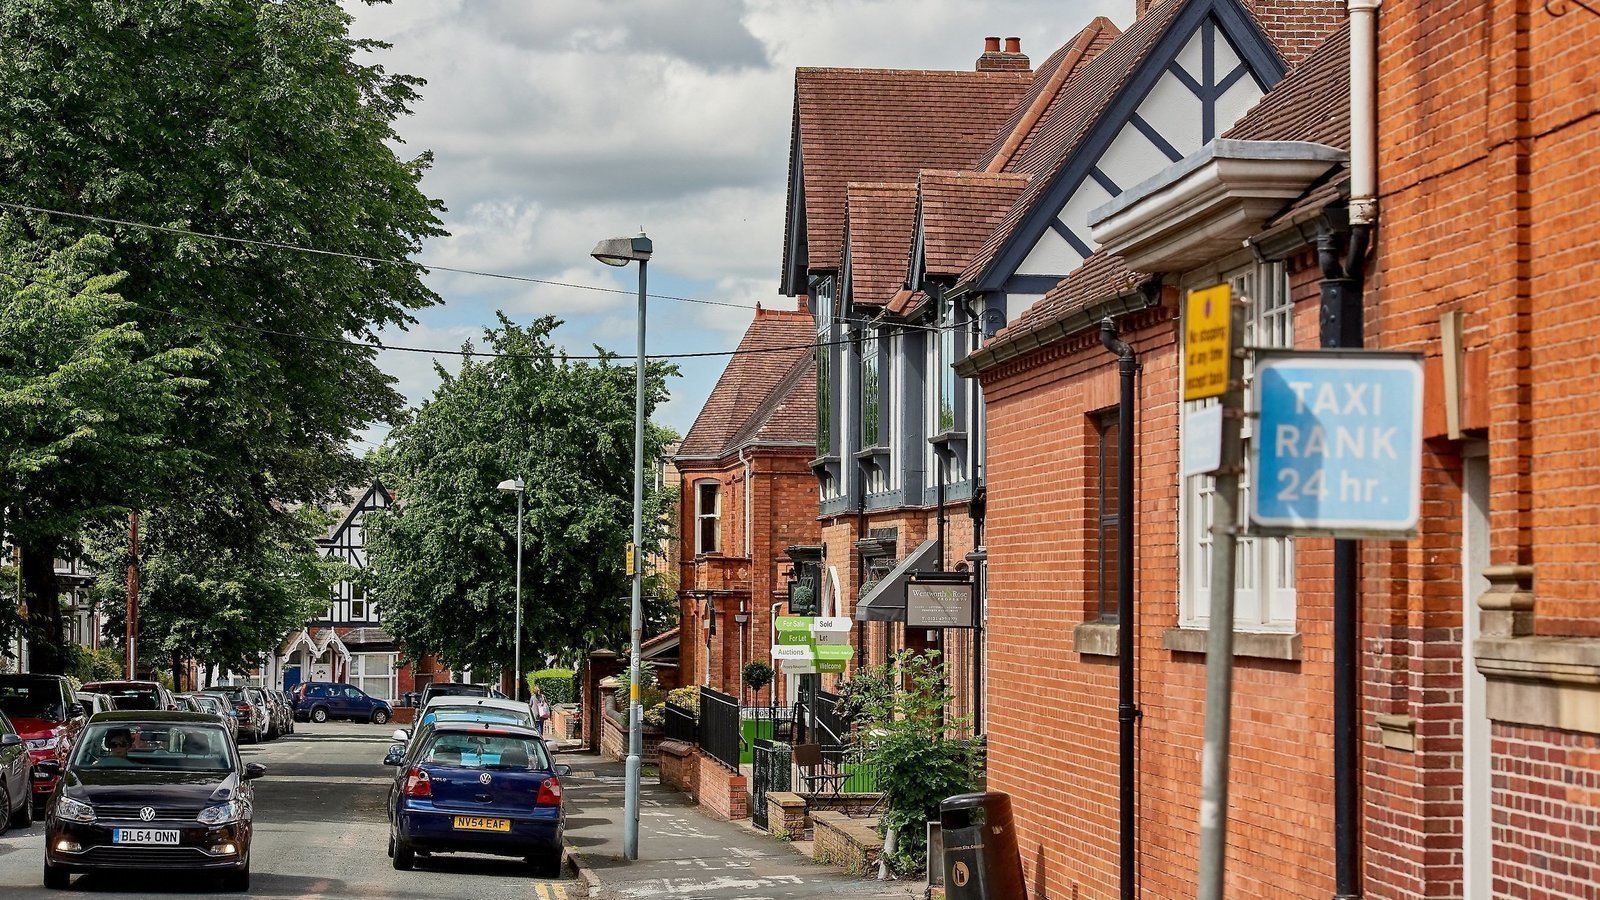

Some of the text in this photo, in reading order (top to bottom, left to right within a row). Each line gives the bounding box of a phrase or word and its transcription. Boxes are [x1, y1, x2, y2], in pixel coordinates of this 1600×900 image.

[1288, 381, 1382, 416] TAXI
[1275, 424, 1398, 460] RANK
[1277, 467, 1389, 504] 24 hr.
[952, 590, 968, 598] Rose
[819, 620, 833, 628] Sold
[819, 662, 841, 670] Welcome
[457, 817, 505, 829] NV54 EAF
[121, 830, 178, 842] BL64 ONN
